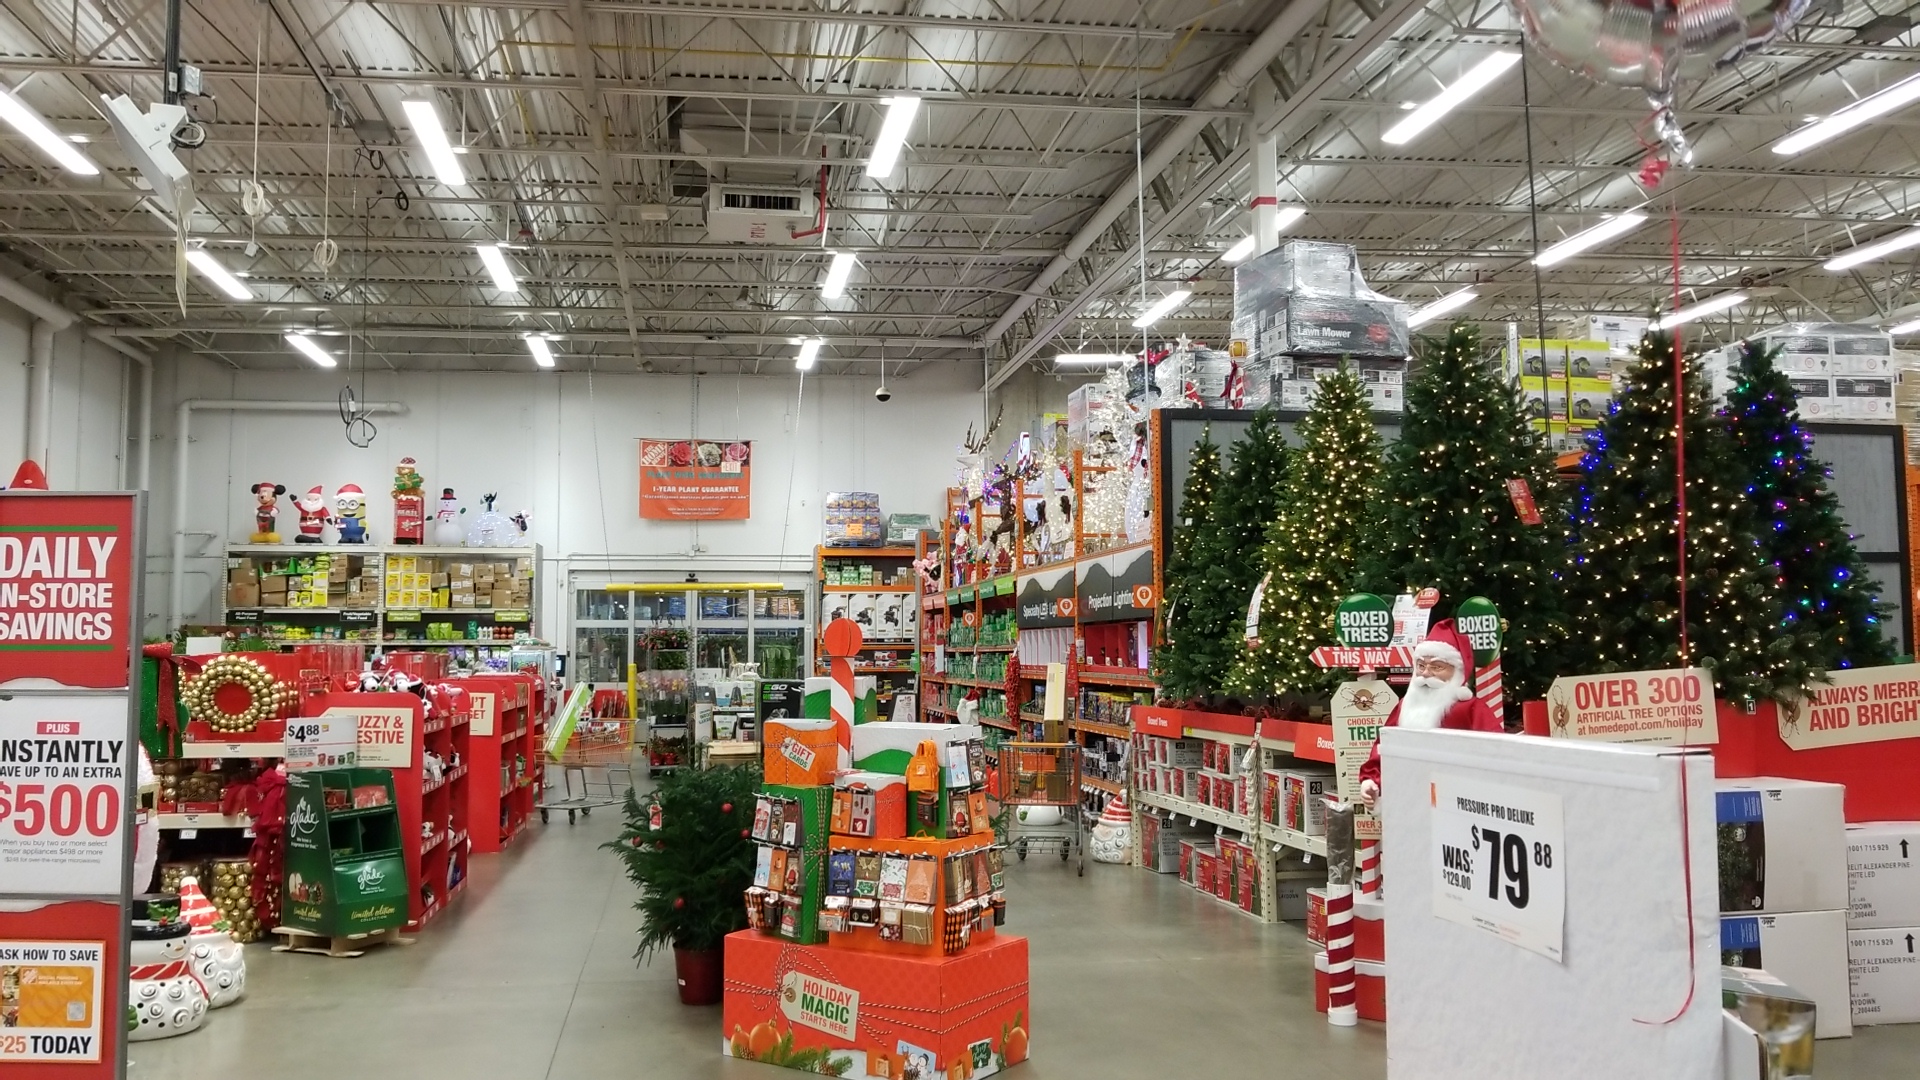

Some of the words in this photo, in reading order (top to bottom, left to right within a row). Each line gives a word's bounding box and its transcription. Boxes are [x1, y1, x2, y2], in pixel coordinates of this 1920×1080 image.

[1297, 325, 1320, 336] Lawn
[1322, 327, 1351, 338] Mower
[0, 536, 117, 579] DAILY
[0, 583, 113, 608] N-STORE
[1088, 592, 1112, 611] Projection
[1113, 589, 1134, 609] Lighting
[0, 612, 112, 640] SAVINGS
[1339, 611, 1389, 627] BOXED
[1458, 614, 1498, 633] BOXED
[1341, 626, 1389, 643] TREES
[1469, 633, 1498, 651] REES
[1332, 651, 1361, 664] THIS
[1364, 651, 1392, 664] WAY
[1574, 678, 1639, 710] OVER
[1648, 675, 1701, 704] 300
[1873, 680, 1920, 700] MERR
[357, 716, 390, 729] UZZY
[393, 716, 404, 729] &
[468, 710, 486, 720] GET
[1347, 718, 1376, 726] CHOOSE
[1378, 717, 1383, 725] A
[1577, 709, 1626, 724] ARTIFICIAL
[1628, 707, 1654, 719] TREE
[1657, 704, 1703, 717] OPTIONS
[1809, 707, 1850, 732] AND
[1857, 699, 1920, 726] BRIGH
[46, 723, 70, 733] PLUS
[1577, 725, 1586, 736] at
[1588, 717, 1704, 734] homedepot.com/holiday
[357, 730, 405, 744] ESTIVE
[0, 739, 123, 763] NSTANTLY
[788, 751, 809, 769] CARDS
[791, 743, 813, 761] GIFT
[0, 766, 21, 777] AVE
[25, 766, 40, 777] UP
[44, 766, 59, 777] TO
[62, 766, 79, 778] AN
[83, 767, 122, 778] EXTRA
[1311, 783, 1321, 795] 28
[0, 781, 119, 837] $500
[1456, 796, 1490, 817] PRESSURE
[1491, 804, 1506, 820] PRO
[1507, 807, 1535, 826] DELUXE
[289, 803, 320, 838] glade
[1356, 820, 1376, 829] OVER
[19, 840, 31, 848] you
[33, 839, 45, 848] buy
[47, 839, 59, 847] two
[1442, 843, 1475, 875] WAS:
[1863, 862, 1897, 870] ALEXANDER
[357, 867, 386, 890] glade
[1442, 869, 1472, 890] $129.00
[0, 949, 19, 960] ASK
[23, 949, 48, 960] HOW
[52, 949, 66, 960] TO
[69, 950, 98, 961] SAVE
[1867, 957, 1901, 965] ALEXANDER
[803, 979, 852, 1007] HOLIDAY
[1850, 998, 1876, 1006] AYDOWN
[801, 993, 850, 1025] MAGIC
[800, 1011, 827, 1028] STARTS
[829, 1021, 848, 1035] HERE
[30, 1036, 92, 1054] TODAY
